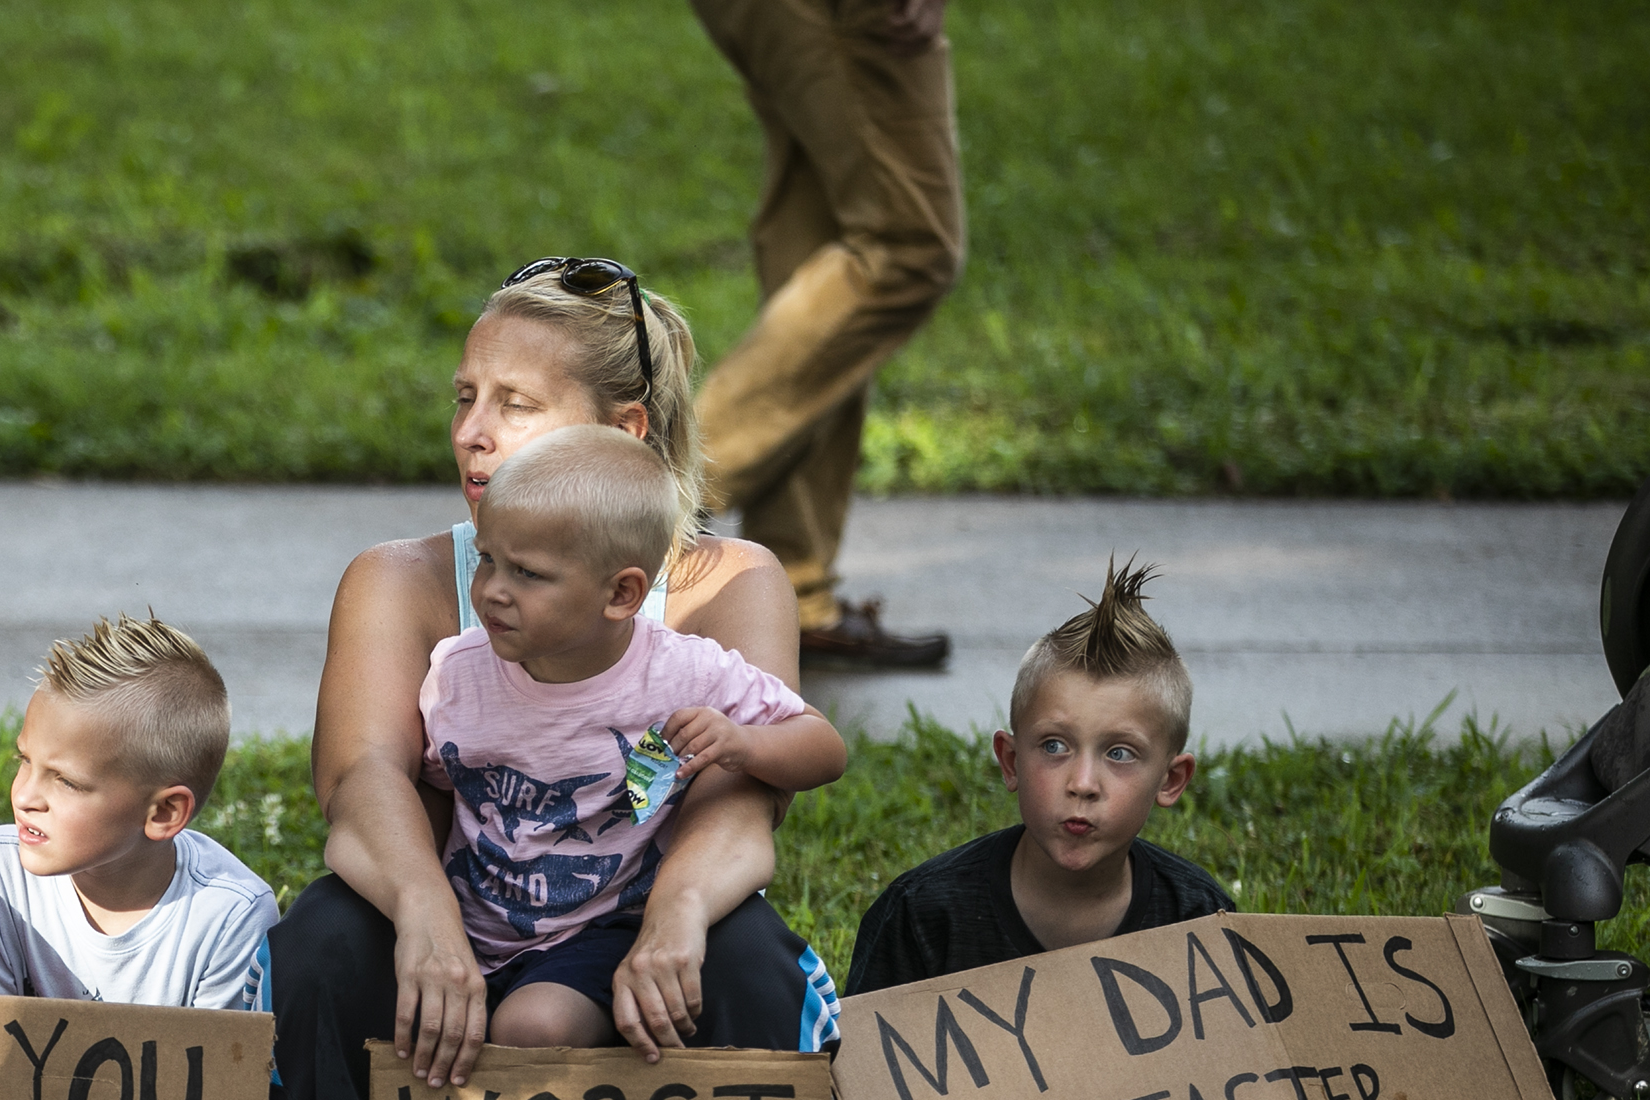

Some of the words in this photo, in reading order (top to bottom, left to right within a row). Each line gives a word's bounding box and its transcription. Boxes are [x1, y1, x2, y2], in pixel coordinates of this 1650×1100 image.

[483, 771, 562, 816] SURF
[479, 864, 549, 907] AND
[1090, 927, 1294, 1056] DAD
[1306, 931, 1456, 1040] IS
